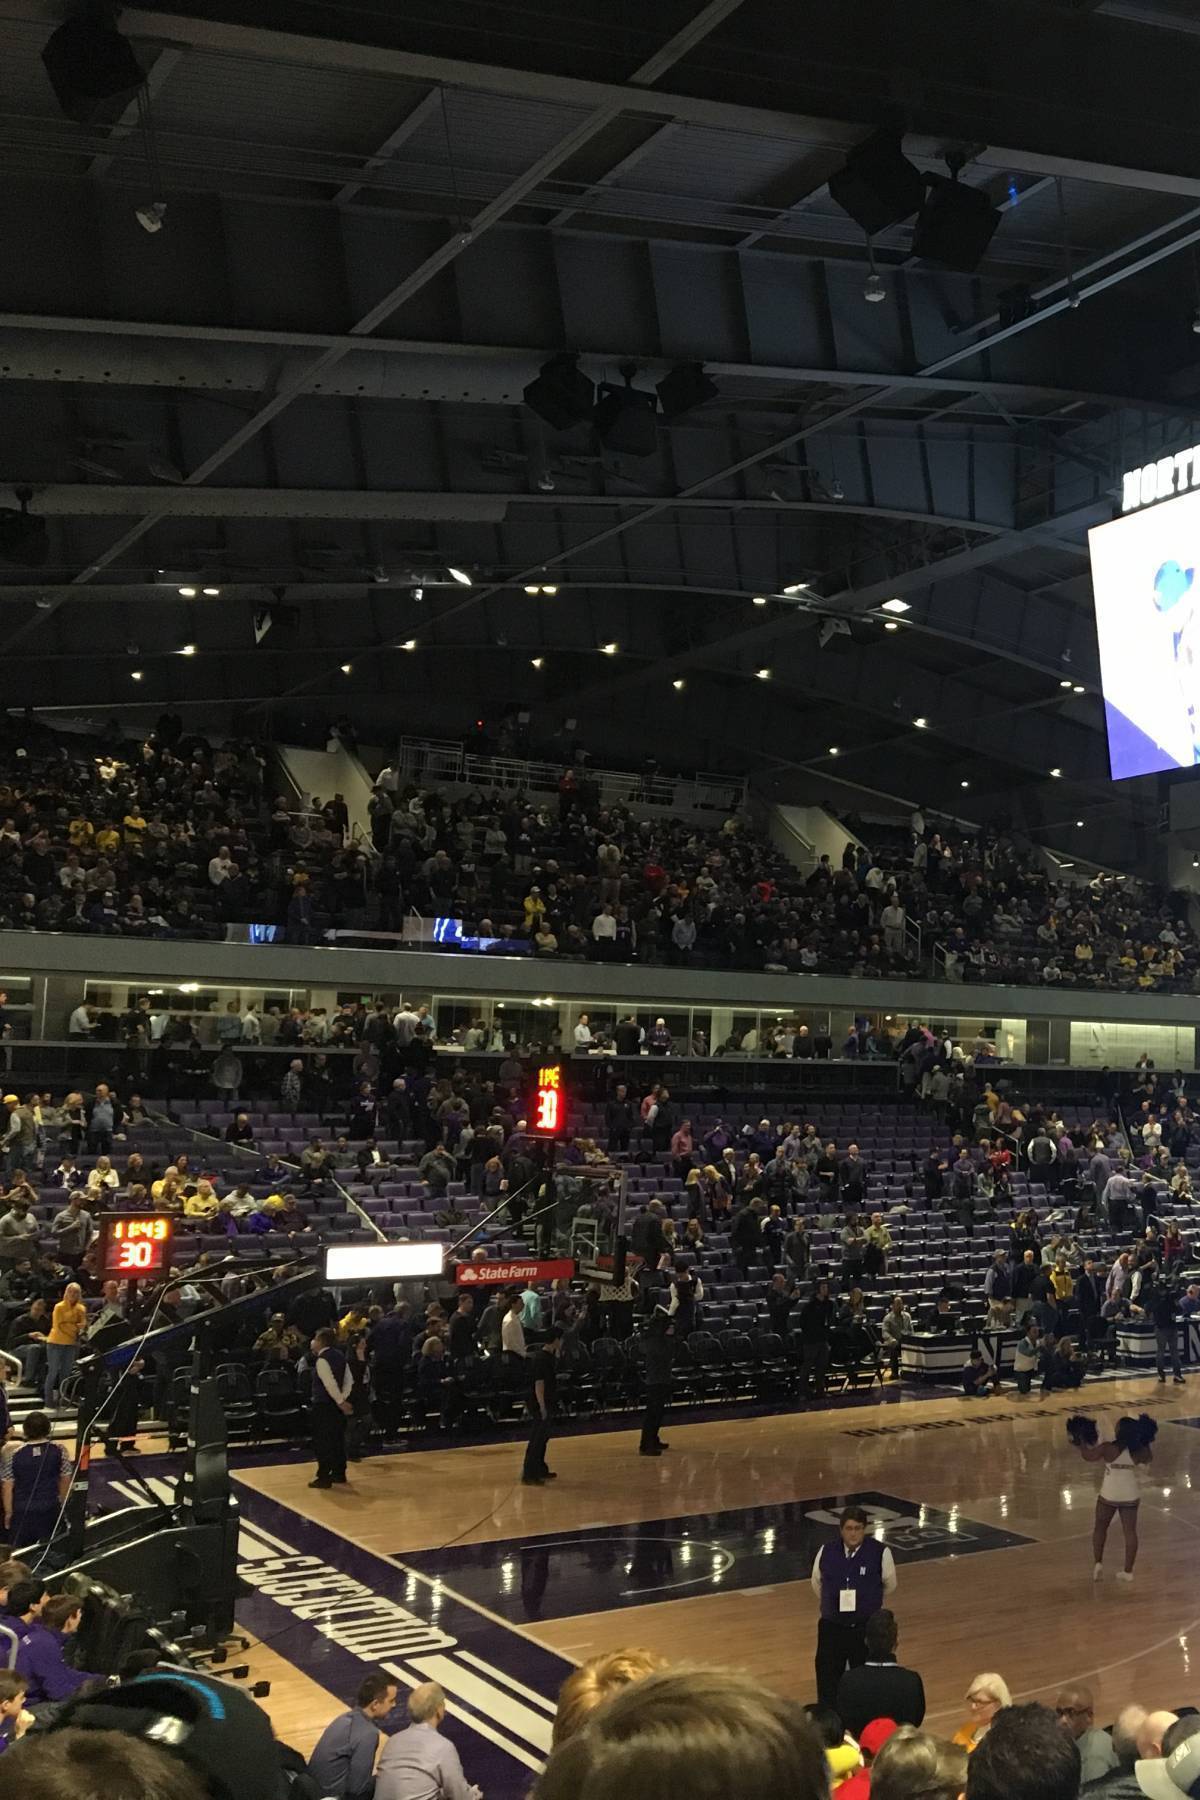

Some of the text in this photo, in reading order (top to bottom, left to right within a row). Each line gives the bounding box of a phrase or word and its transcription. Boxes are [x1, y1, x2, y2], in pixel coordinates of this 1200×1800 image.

[537, 1090, 558, 1129] 30
[120, 1242, 152, 1268] 30
[236, 1556, 458, 1662] WILDCATS
